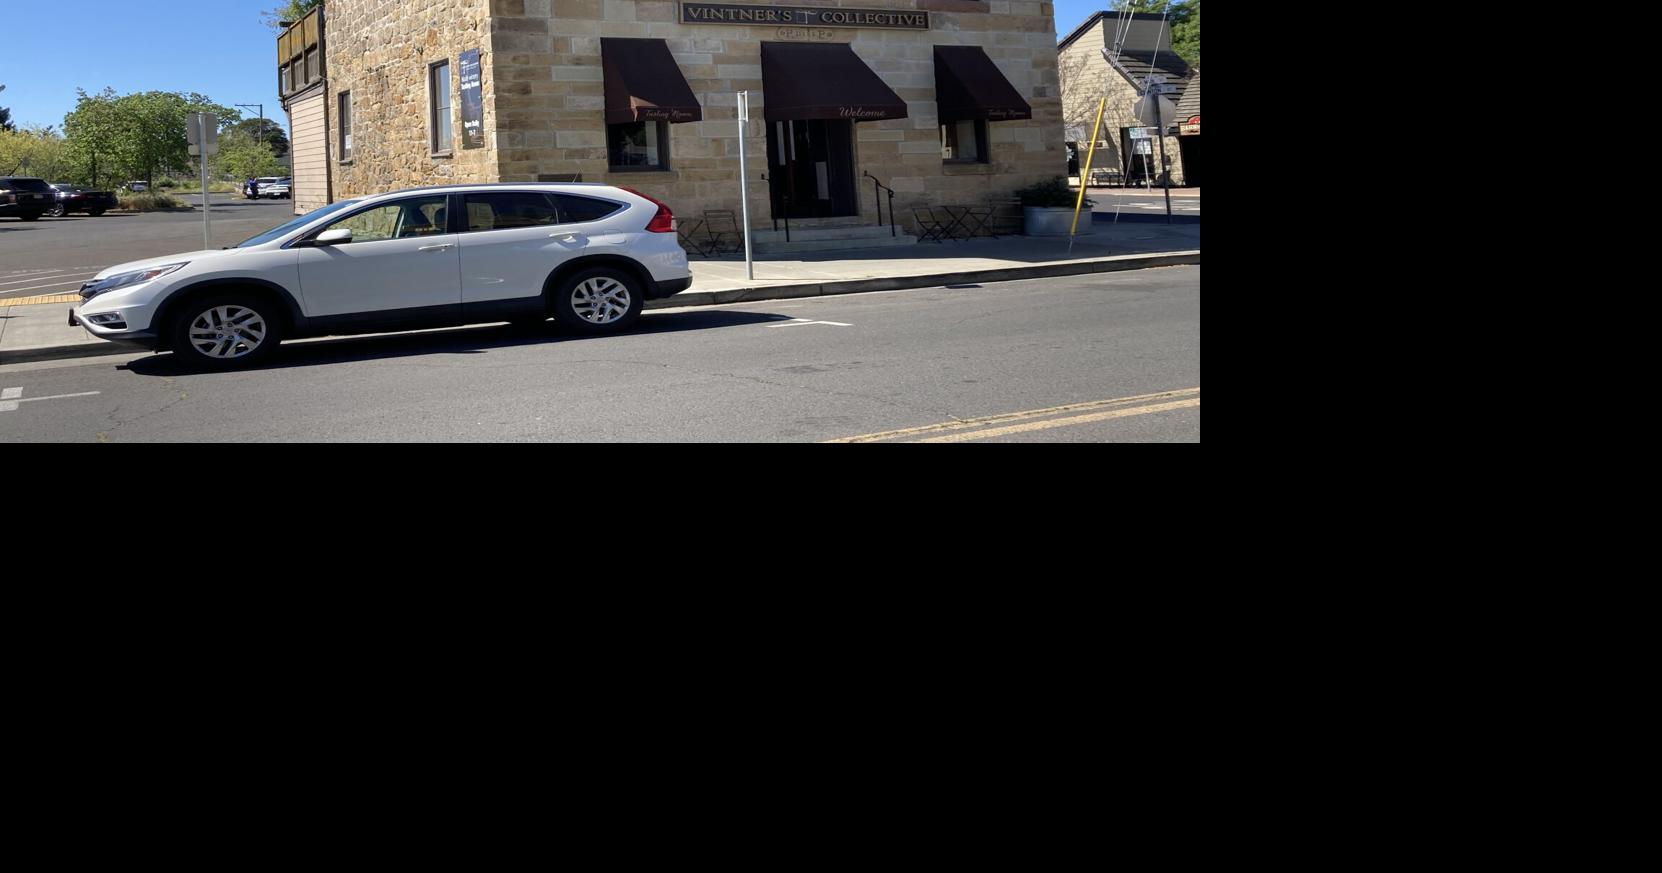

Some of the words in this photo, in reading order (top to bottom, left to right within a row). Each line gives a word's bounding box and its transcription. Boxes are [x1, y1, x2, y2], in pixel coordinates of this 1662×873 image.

[687, 7, 792, 22] VINTNER'S
[821, 11, 925, 26] COLLECTIVE
[839, 106, 887, 118] Welcome
